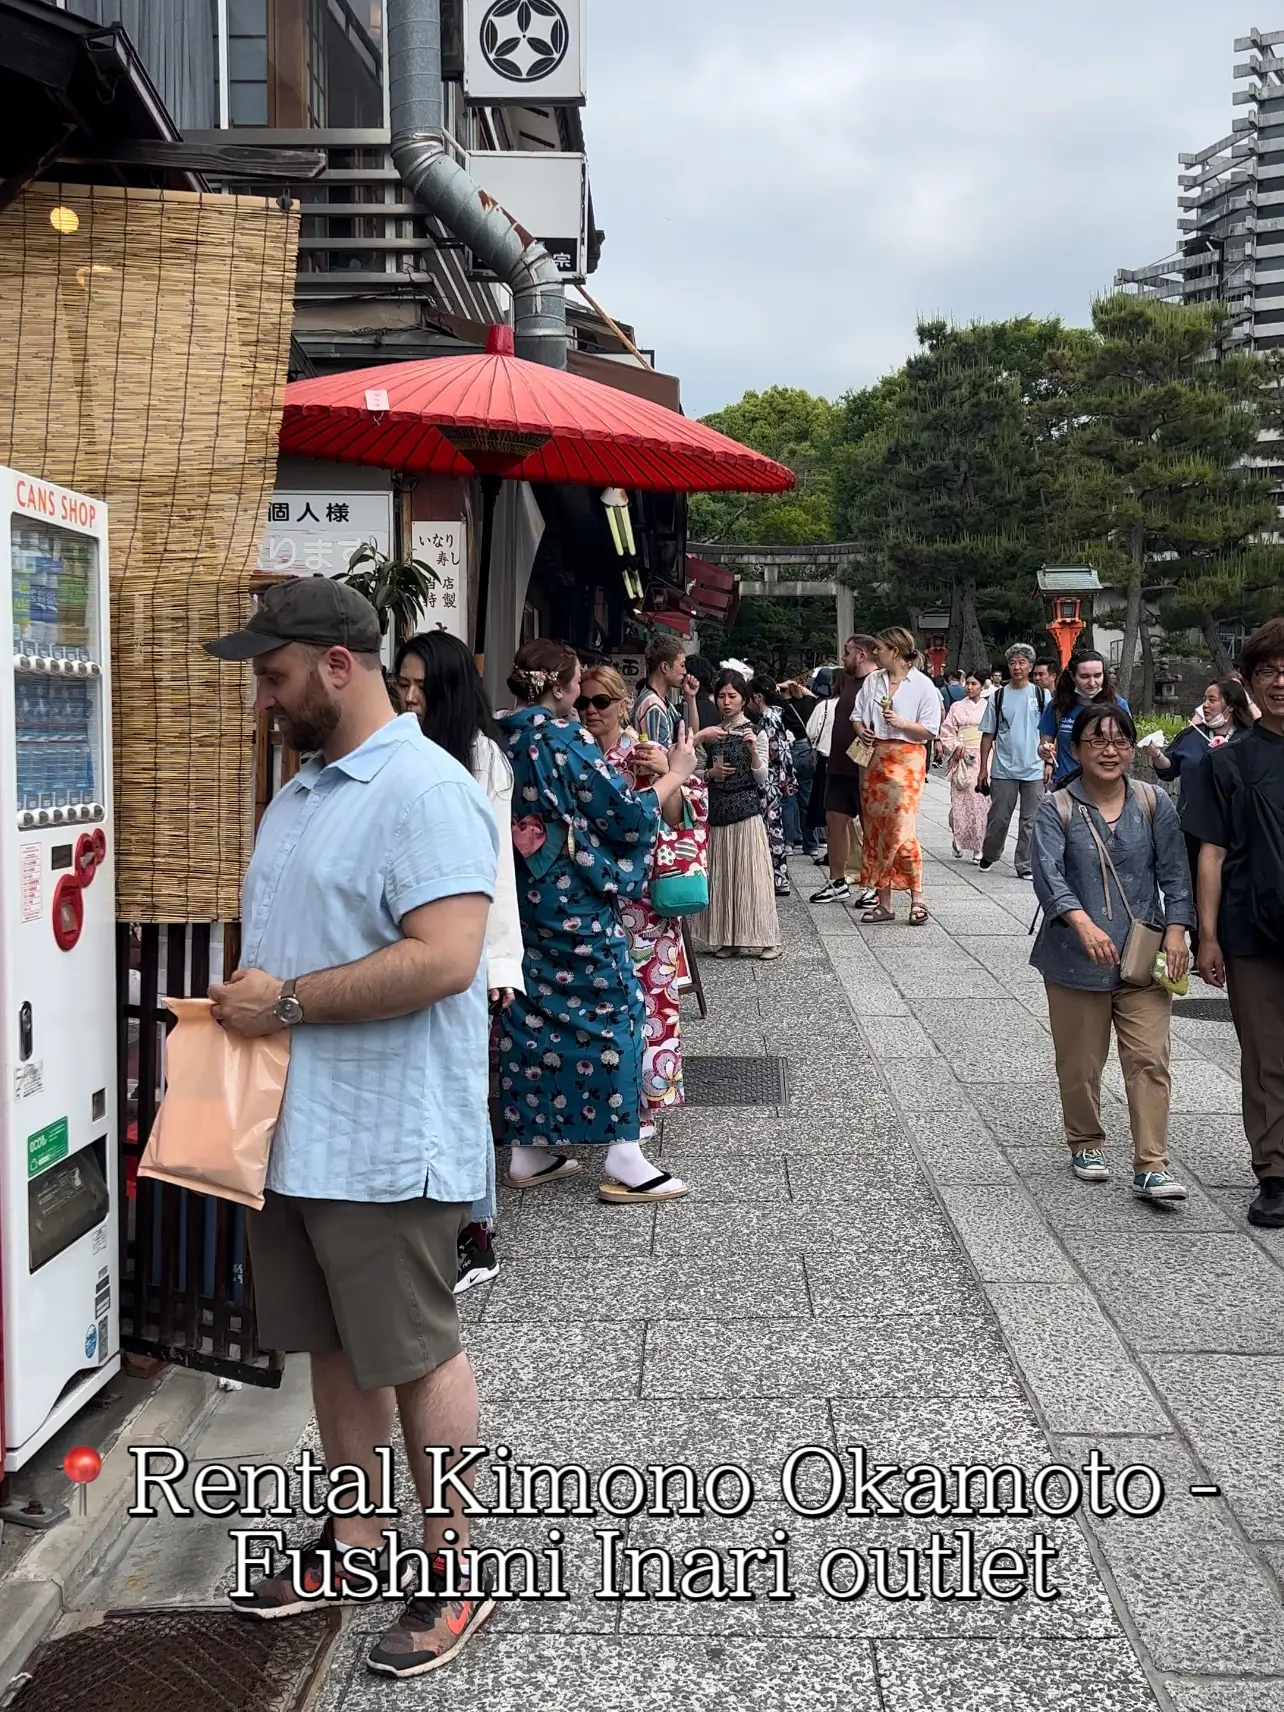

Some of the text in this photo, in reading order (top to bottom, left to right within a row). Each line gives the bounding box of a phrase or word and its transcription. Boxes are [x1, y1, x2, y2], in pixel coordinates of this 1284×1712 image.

[16, 480, 96, 528] CANS SHOP
[268, 502, 350, 522] 個人様
[419, 533, 454, 548] いなり
[436, 551, 461, 567] 寿し
